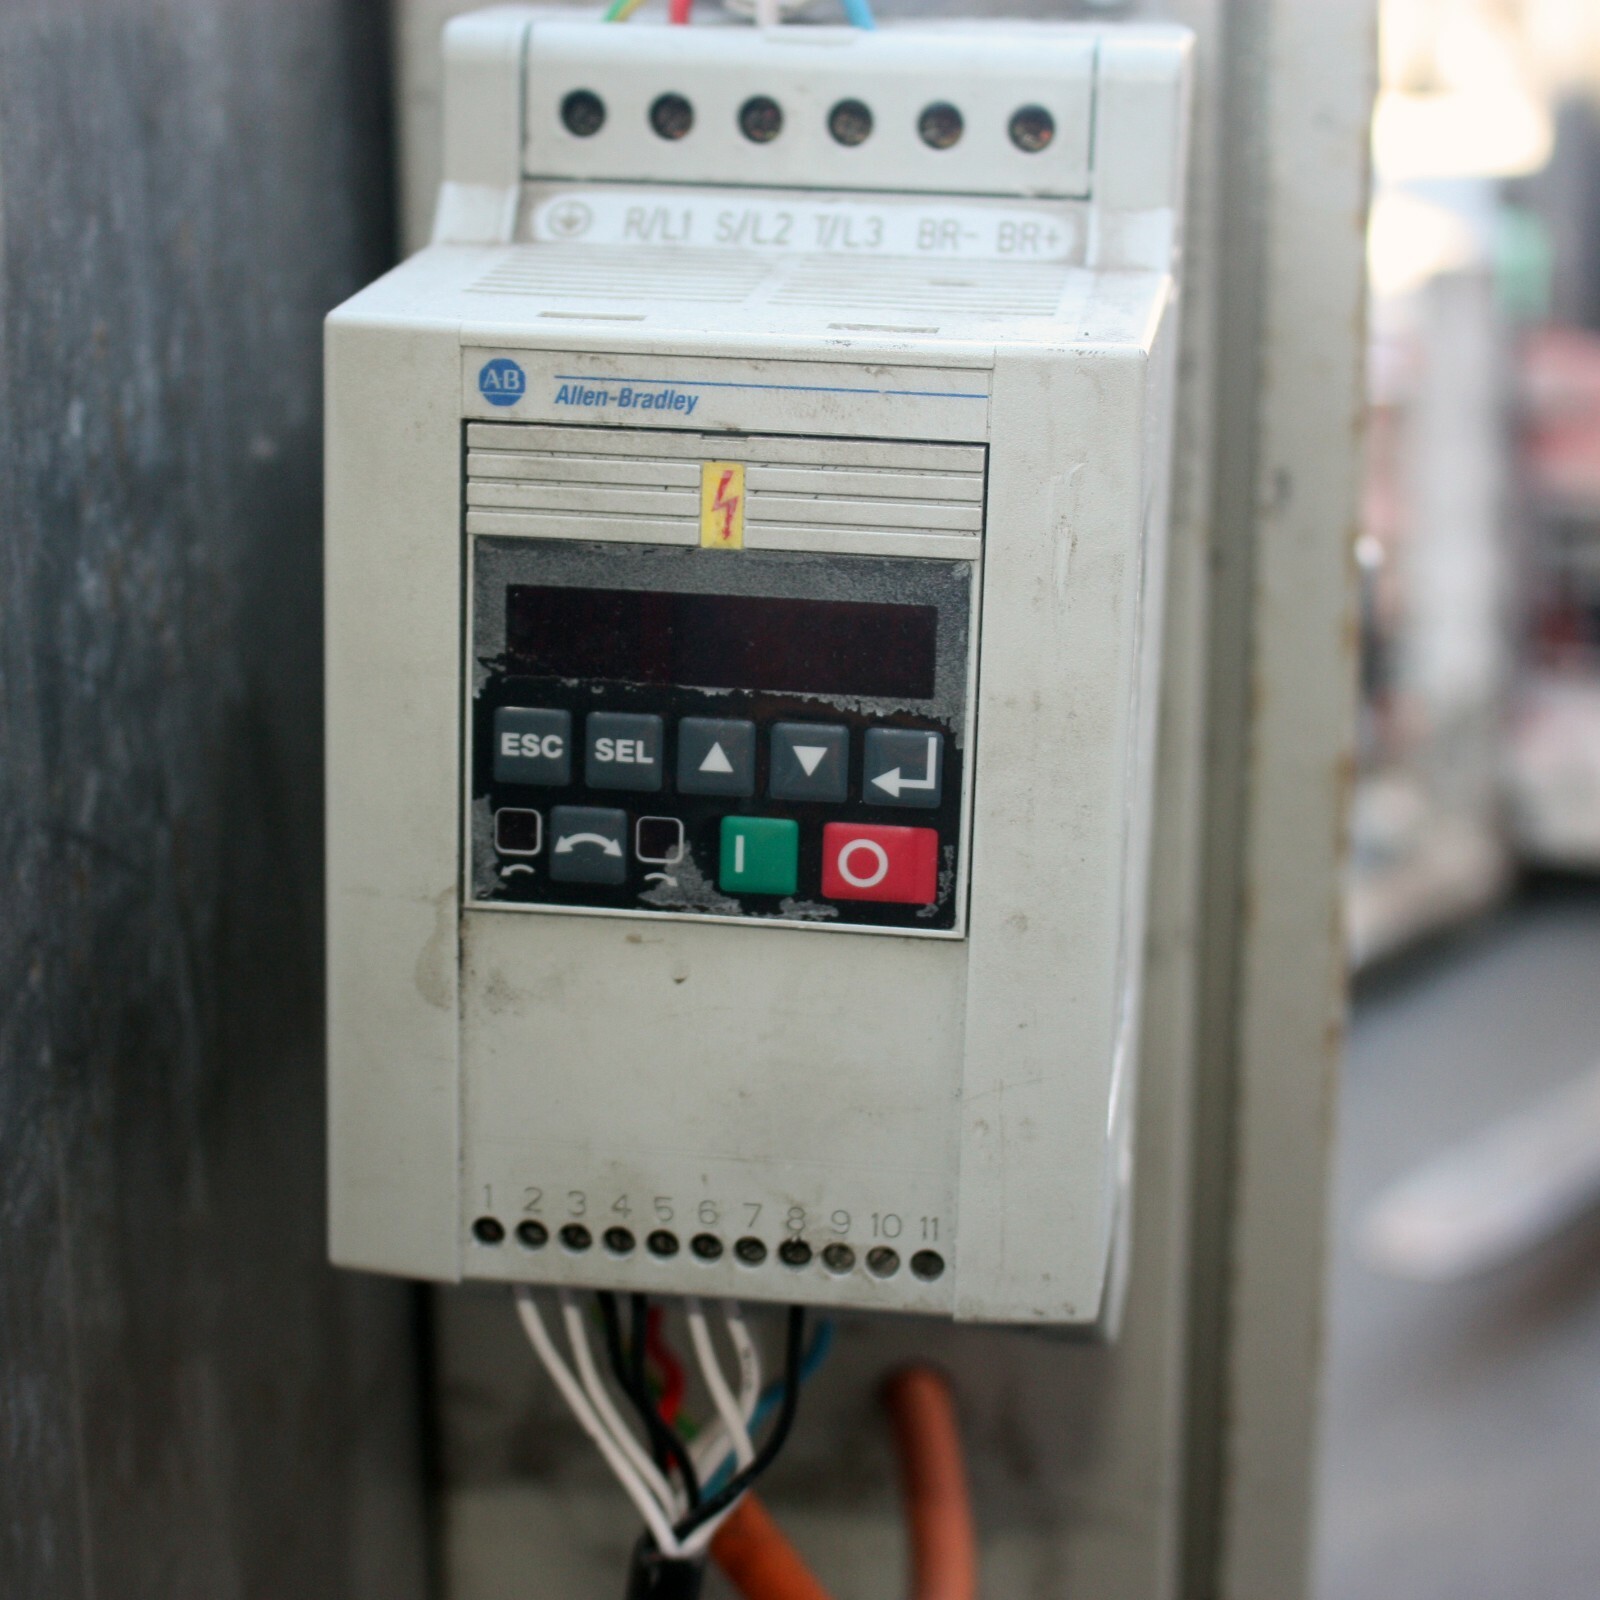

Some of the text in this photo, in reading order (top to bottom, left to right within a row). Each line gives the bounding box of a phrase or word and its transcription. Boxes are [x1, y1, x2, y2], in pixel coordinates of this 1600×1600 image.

[624, 208, 693, 243] R/L1
[715, 210, 792, 247] S/L2
[814, 213, 883, 249] T/L3
[997, 223, 1060, 253] BR+
[554, 383, 699, 414] Allen-Bradley
[500, 732, 564, 759] ESC
[594, 738, 654, 764] SEL
[484, 1184, 939, 1241] 1 2 3 4 5 6 7 8 9 10 11
